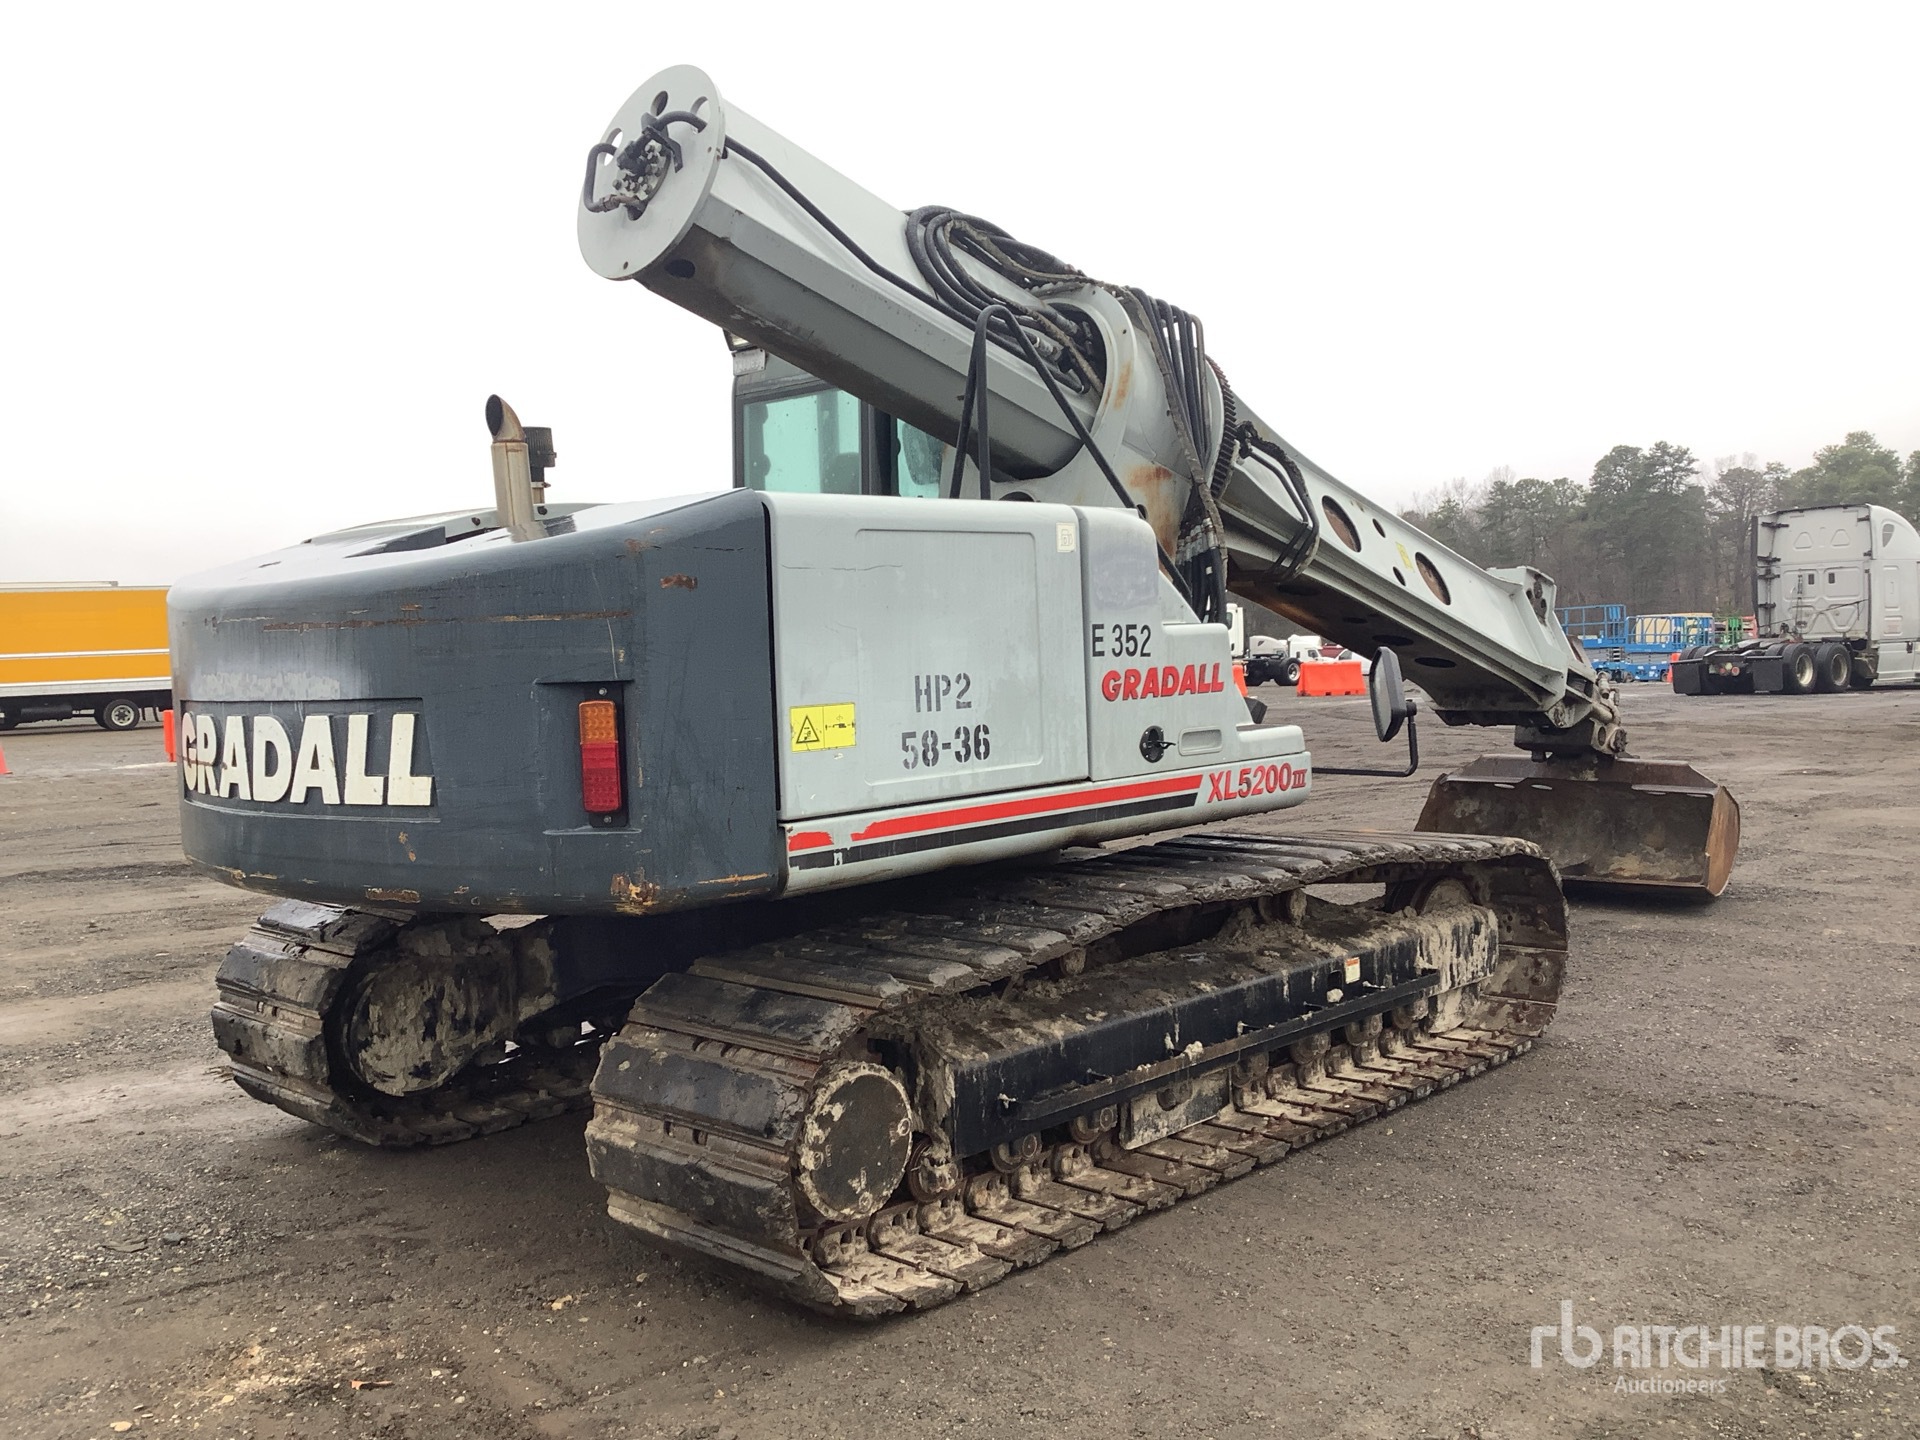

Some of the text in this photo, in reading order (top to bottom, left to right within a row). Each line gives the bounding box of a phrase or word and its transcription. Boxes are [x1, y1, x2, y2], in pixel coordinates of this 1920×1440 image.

[1092, 624, 1151, 657] E 352
[915, 672, 972, 713] HP2
[1102, 662, 1224, 702] GRADALL
[182, 712, 432, 806] GRADALL
[901, 724, 990, 770] 58-36
